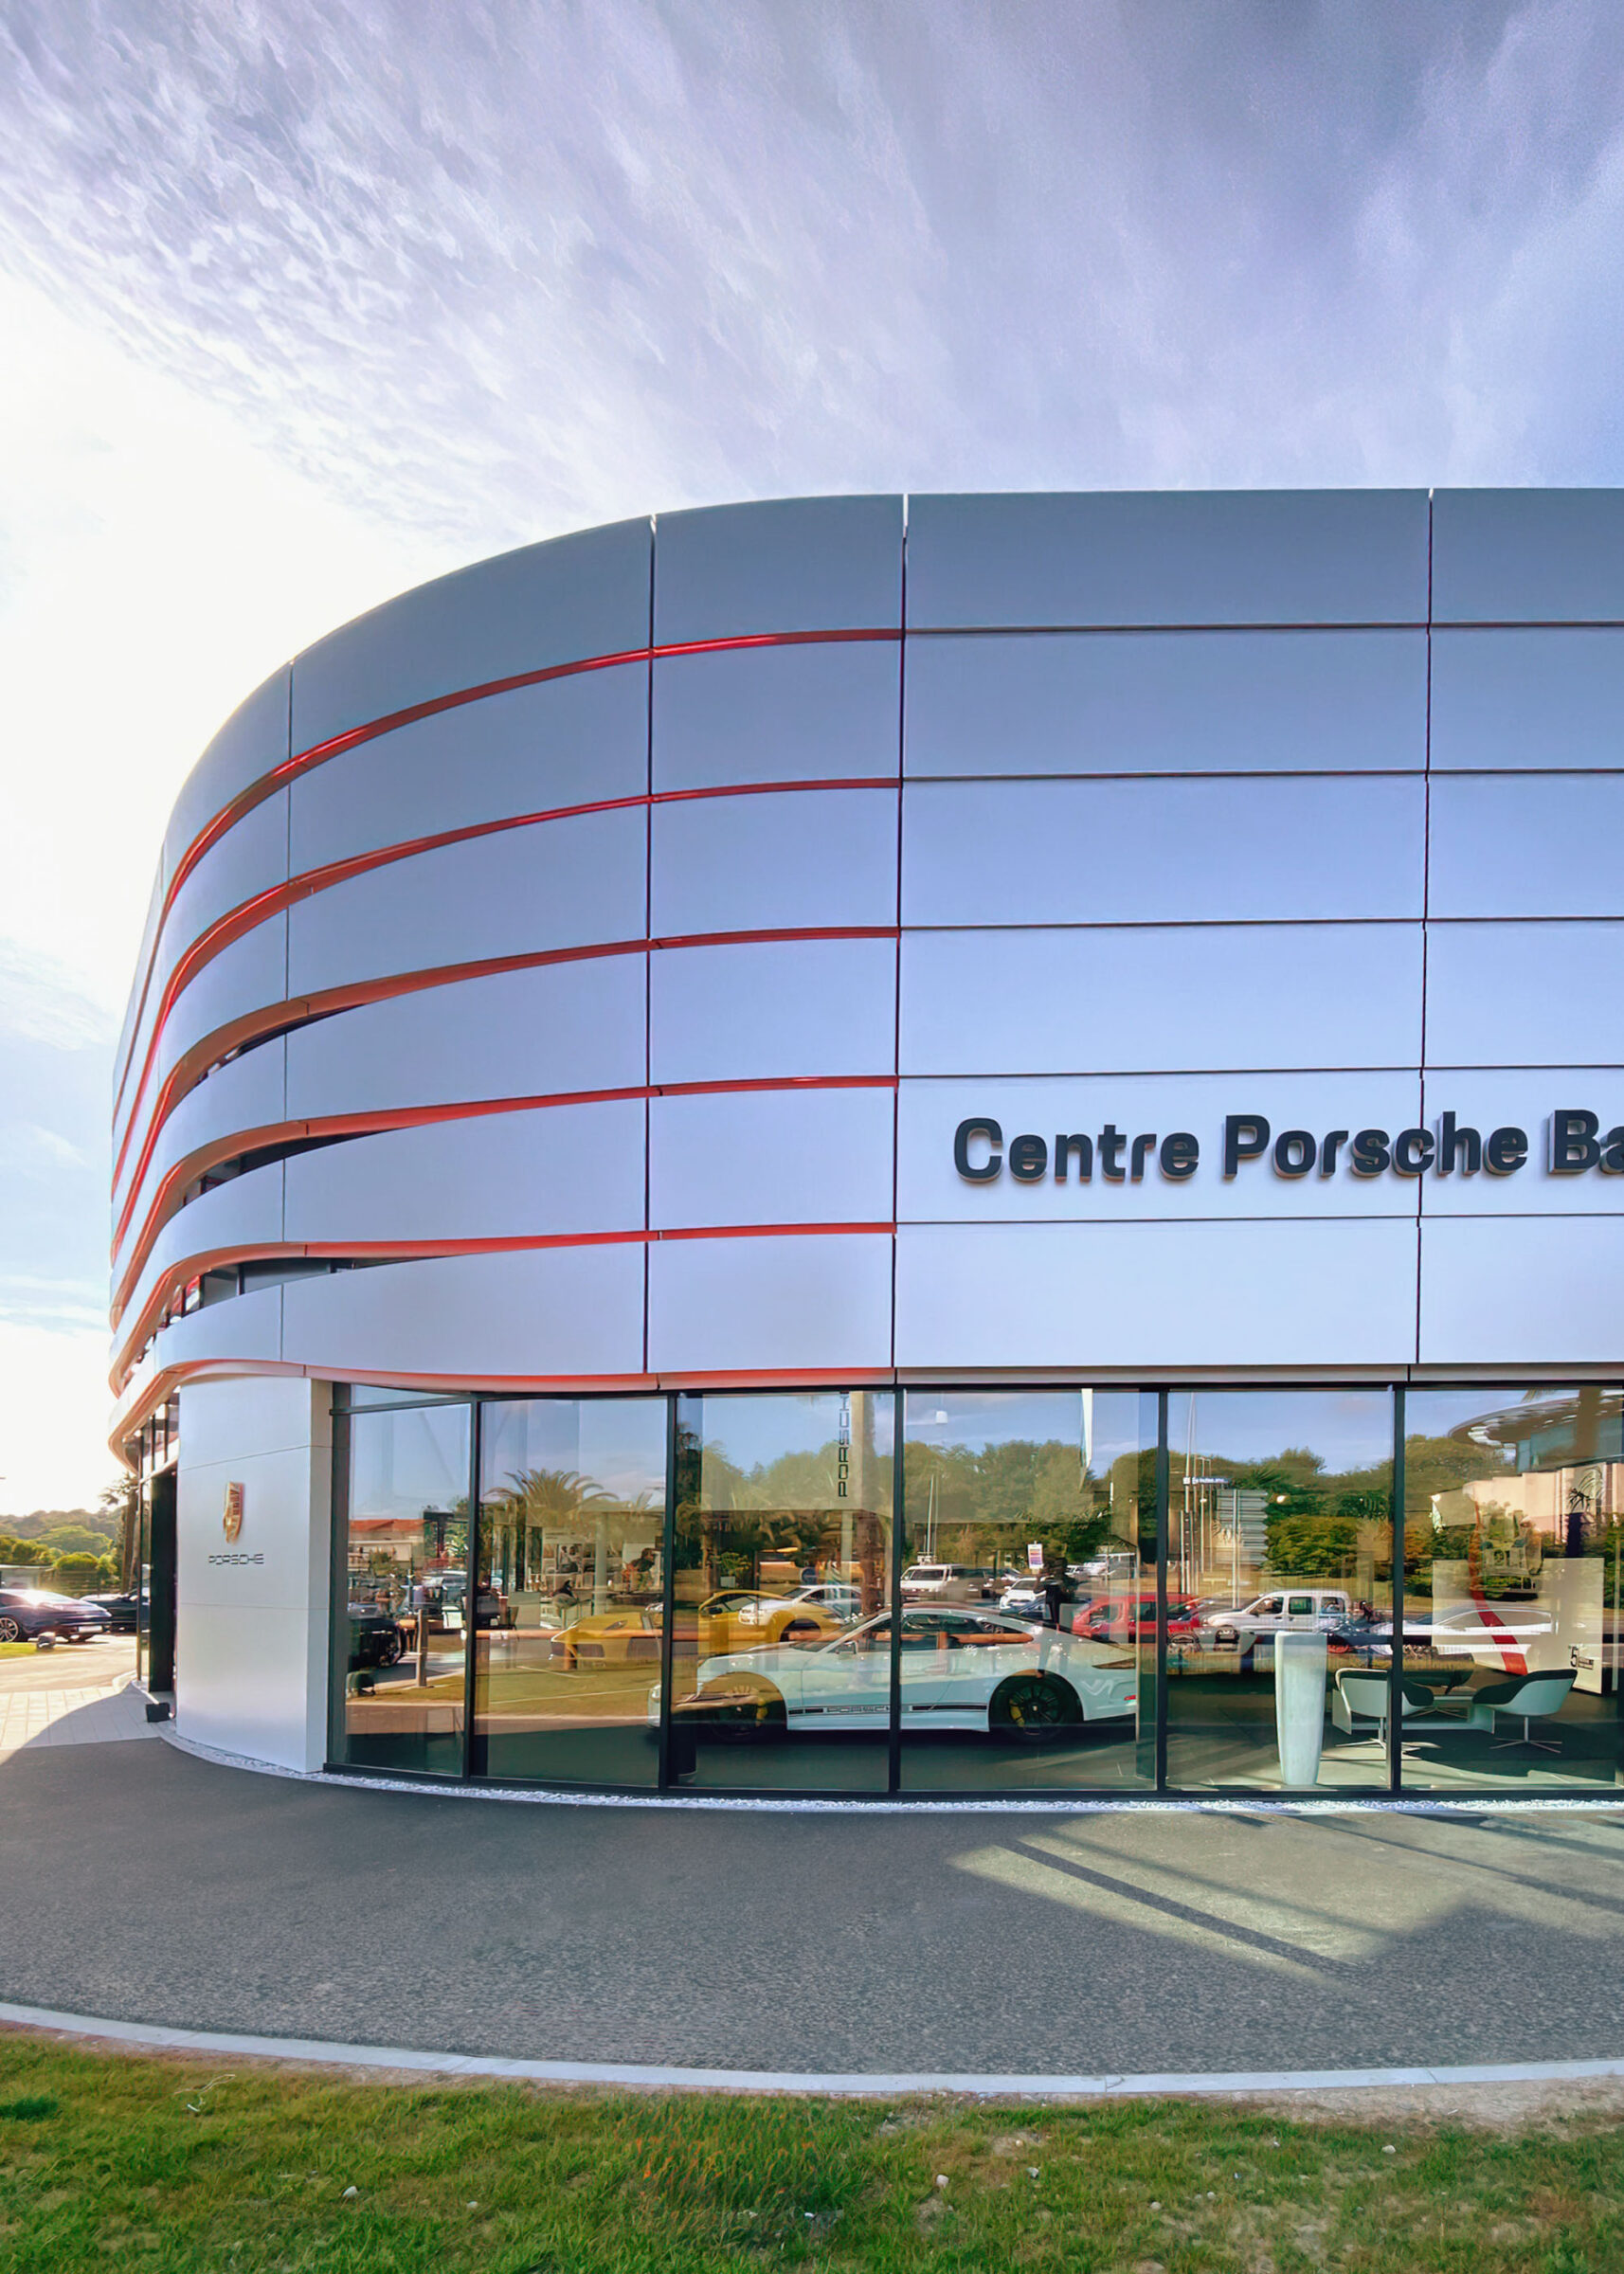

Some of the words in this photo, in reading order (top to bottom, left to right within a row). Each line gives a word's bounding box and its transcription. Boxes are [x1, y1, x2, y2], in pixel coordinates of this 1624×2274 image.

[953, 1116, 1200, 1183] Centre
[1224, 1110, 1529, 1179] Porsche
[838, 1391, 850, 1498] PORSCH
